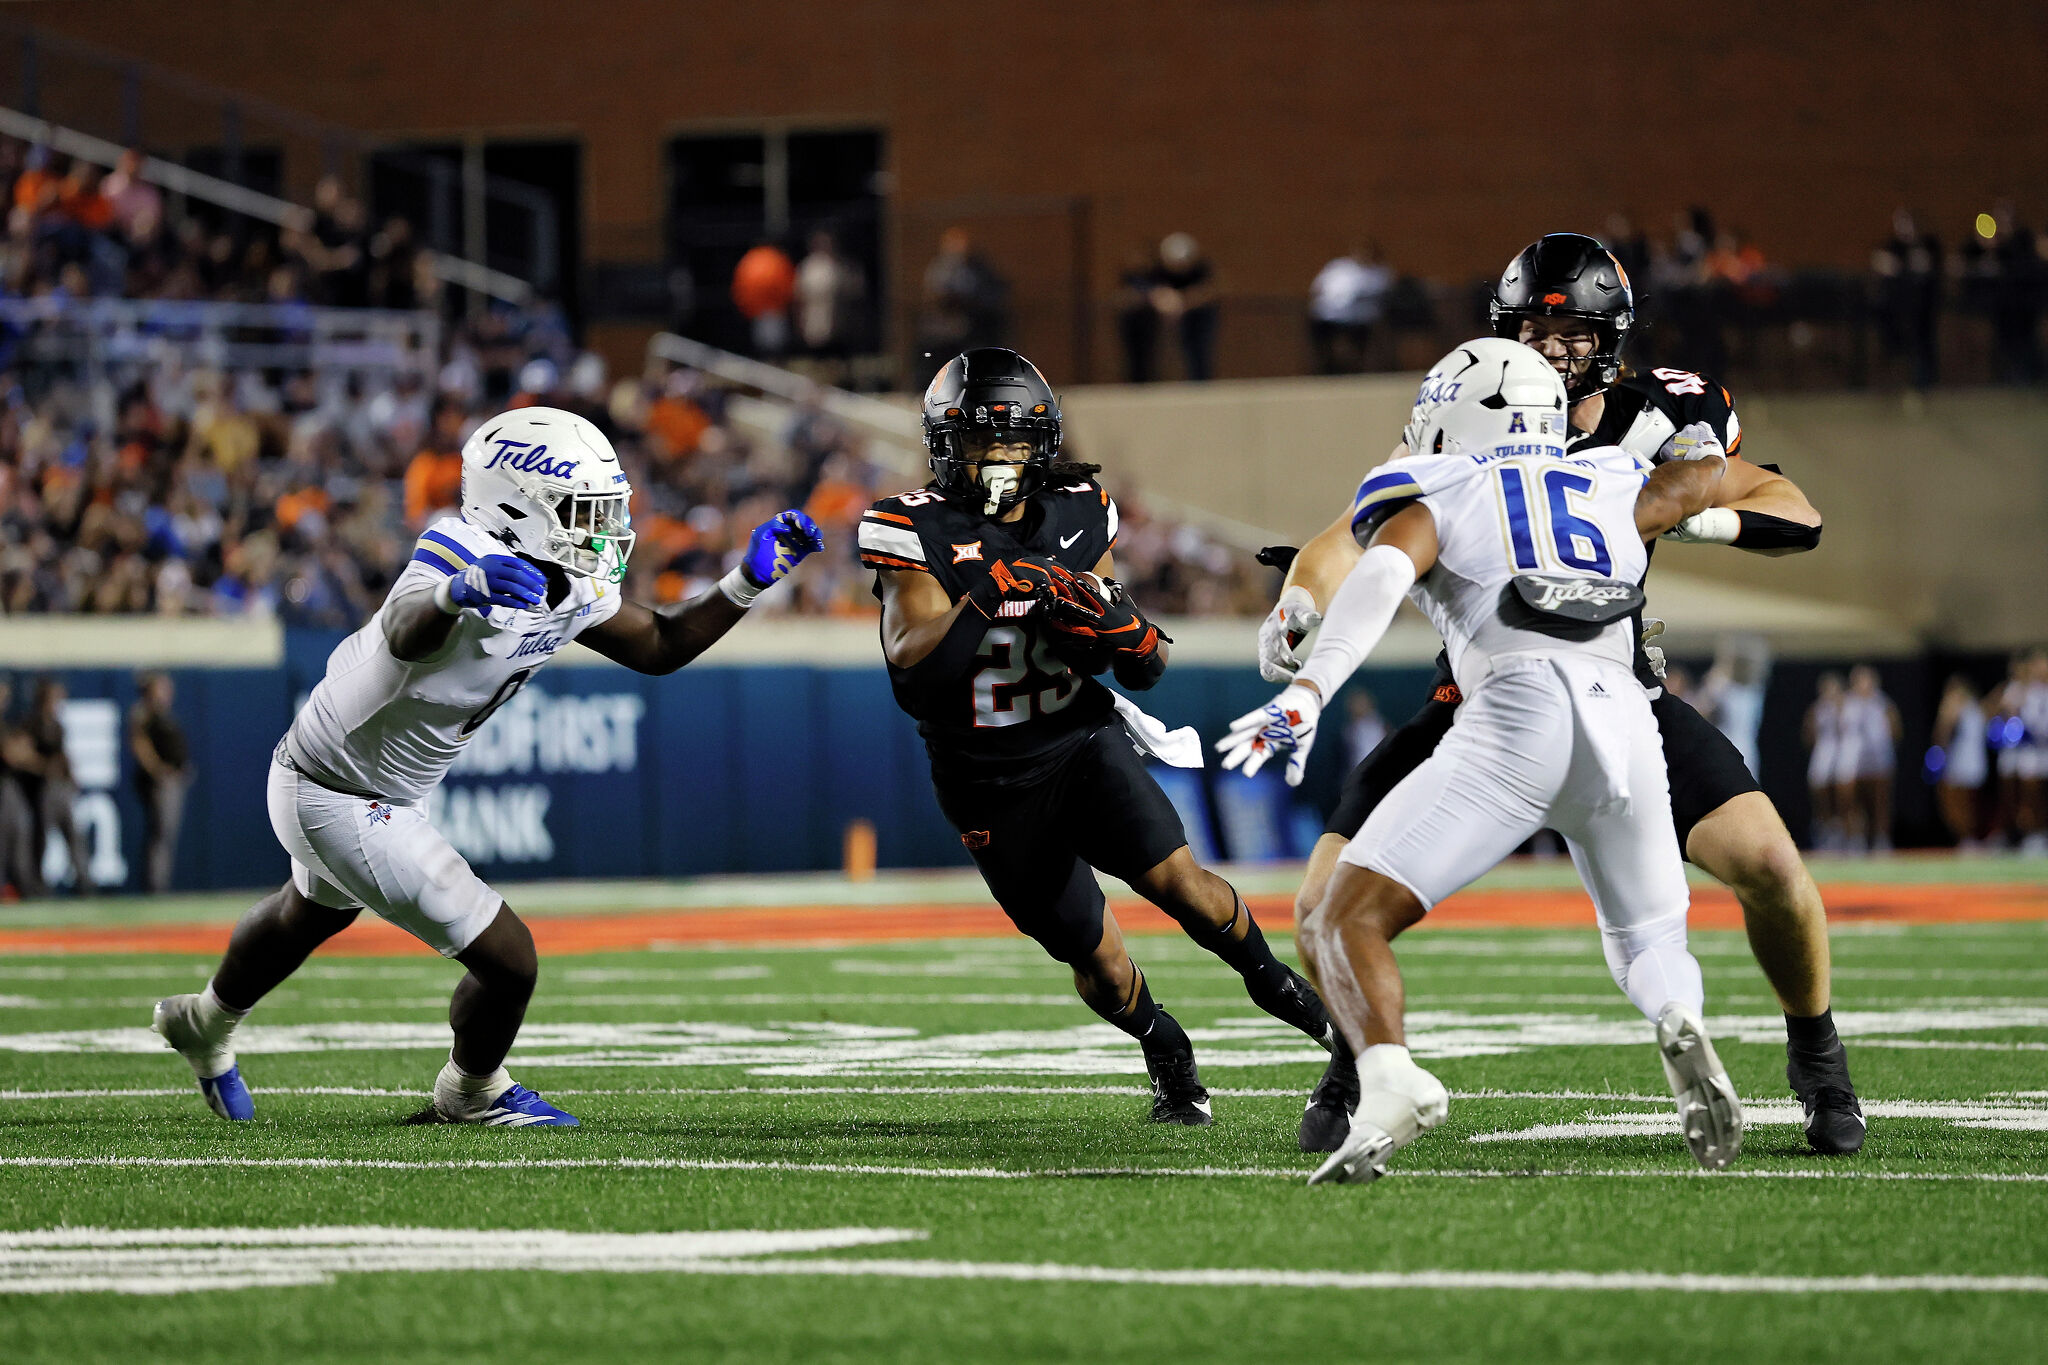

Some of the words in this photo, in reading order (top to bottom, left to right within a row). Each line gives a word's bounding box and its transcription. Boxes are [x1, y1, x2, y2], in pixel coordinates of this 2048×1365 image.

[483, 439, 577, 480] Tulsa
[1495, 444, 1541, 458] TULSA'S
[1545, 445, 1564, 459] TE
[1499, 468, 1612, 578] 16
[951, 541, 983, 565] XII
[1526, 575, 1631, 610] Tulsa
[505, 629, 563, 660] Tulsa
[973, 625, 1082, 728] 25
